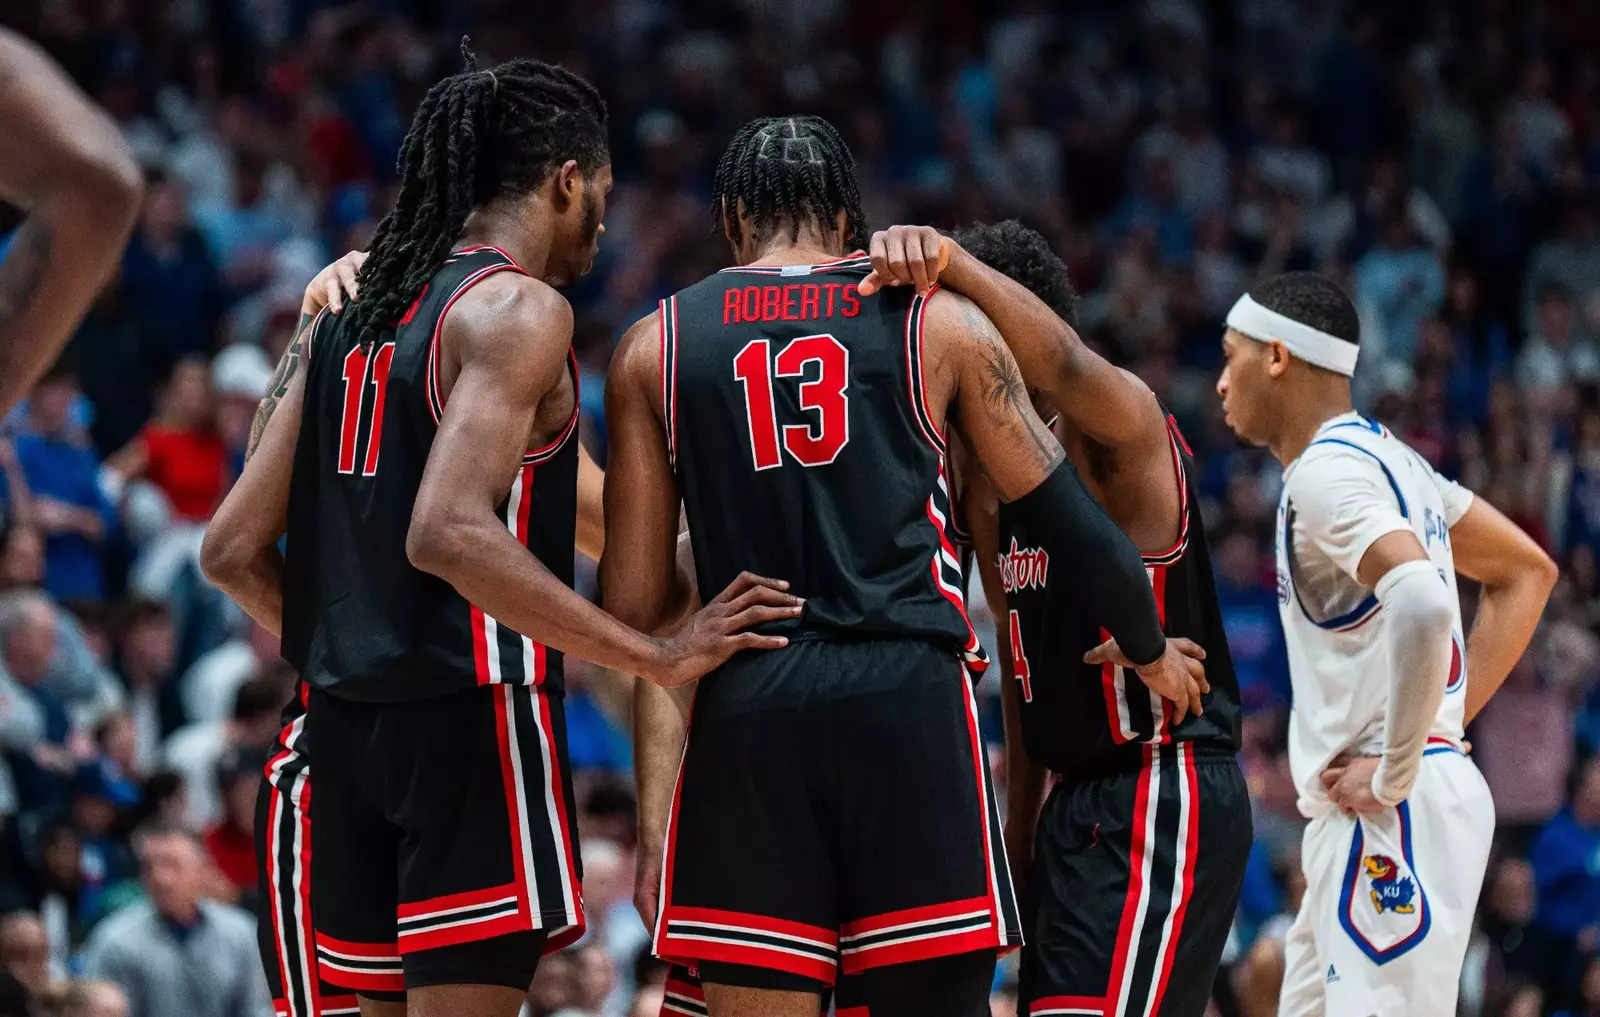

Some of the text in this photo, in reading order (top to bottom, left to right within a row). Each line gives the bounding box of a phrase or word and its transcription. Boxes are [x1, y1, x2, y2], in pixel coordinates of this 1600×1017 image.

[723, 283, 861, 325] ROBERTS
[338, 341, 396, 476] 11
[733, 334, 849, 471] 13
[1384, 886, 1400, 898] KU
